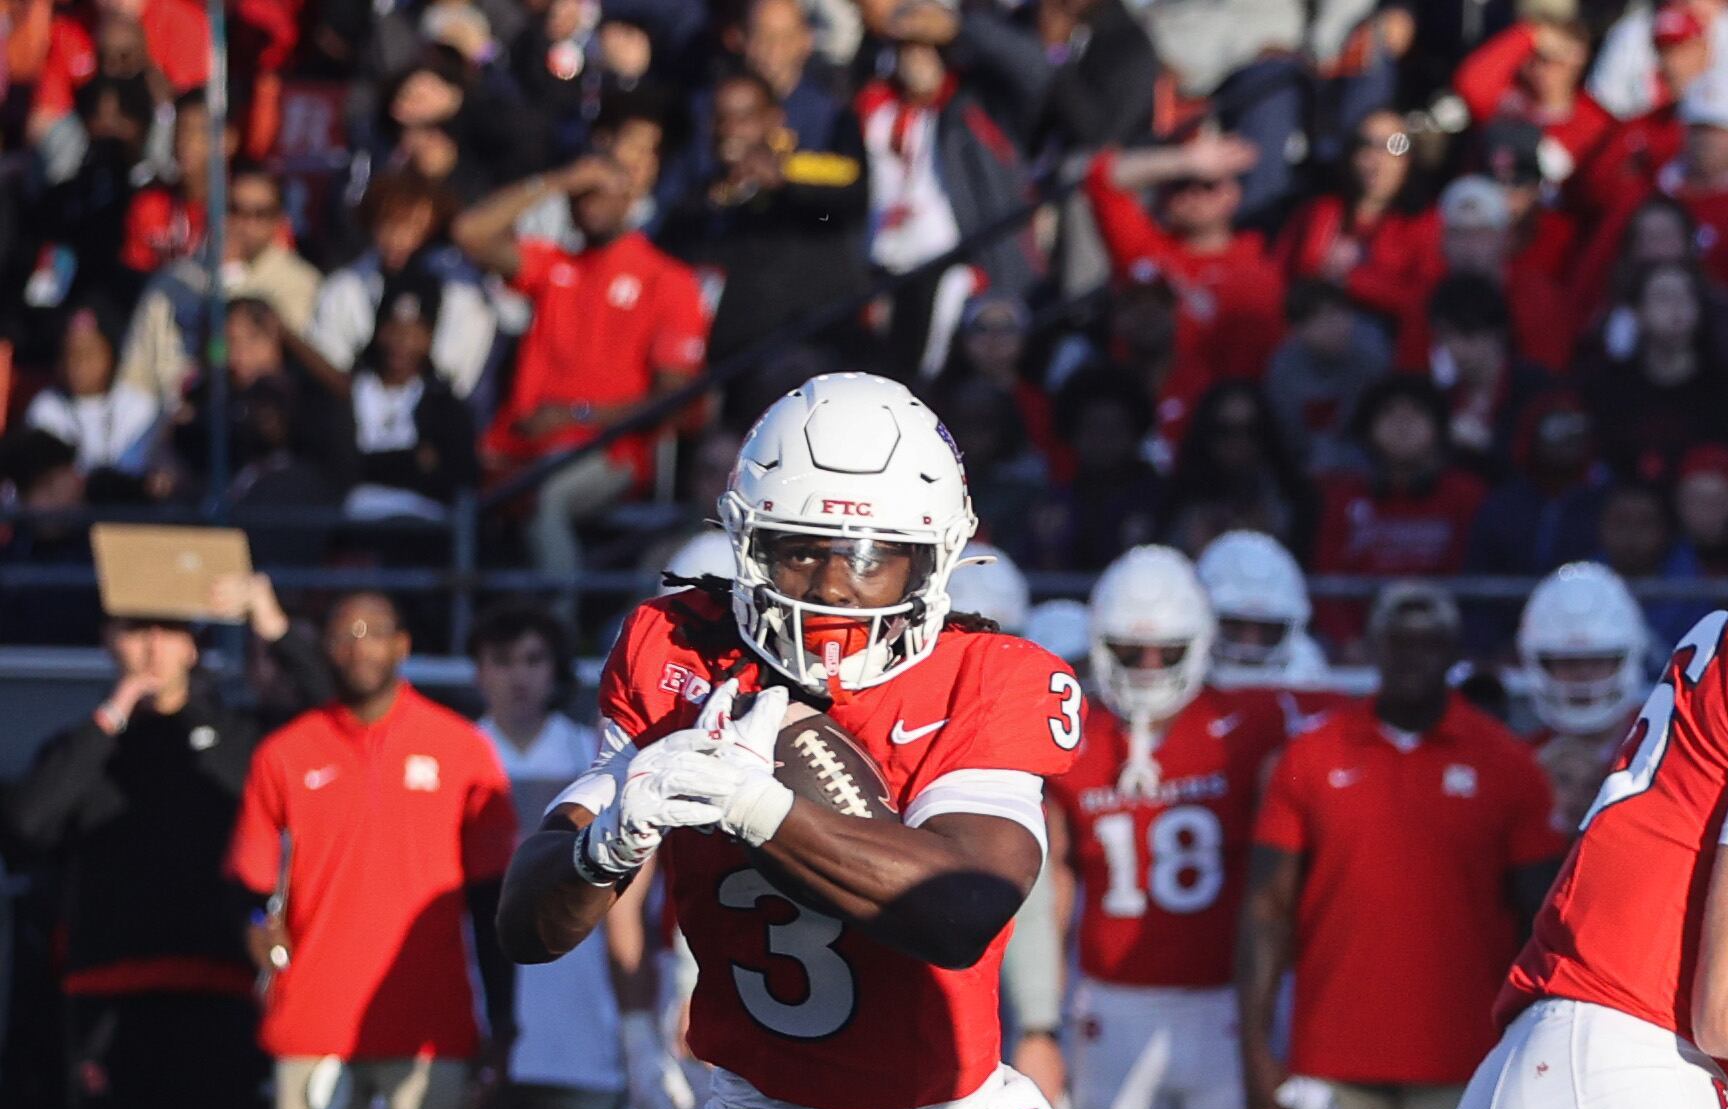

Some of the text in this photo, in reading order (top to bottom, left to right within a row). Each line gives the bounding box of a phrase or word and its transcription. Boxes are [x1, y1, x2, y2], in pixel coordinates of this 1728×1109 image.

[1049, 671, 1082, 750] 3
[1094, 804, 1224, 919] 18
[716, 865, 857, 1041] 3
